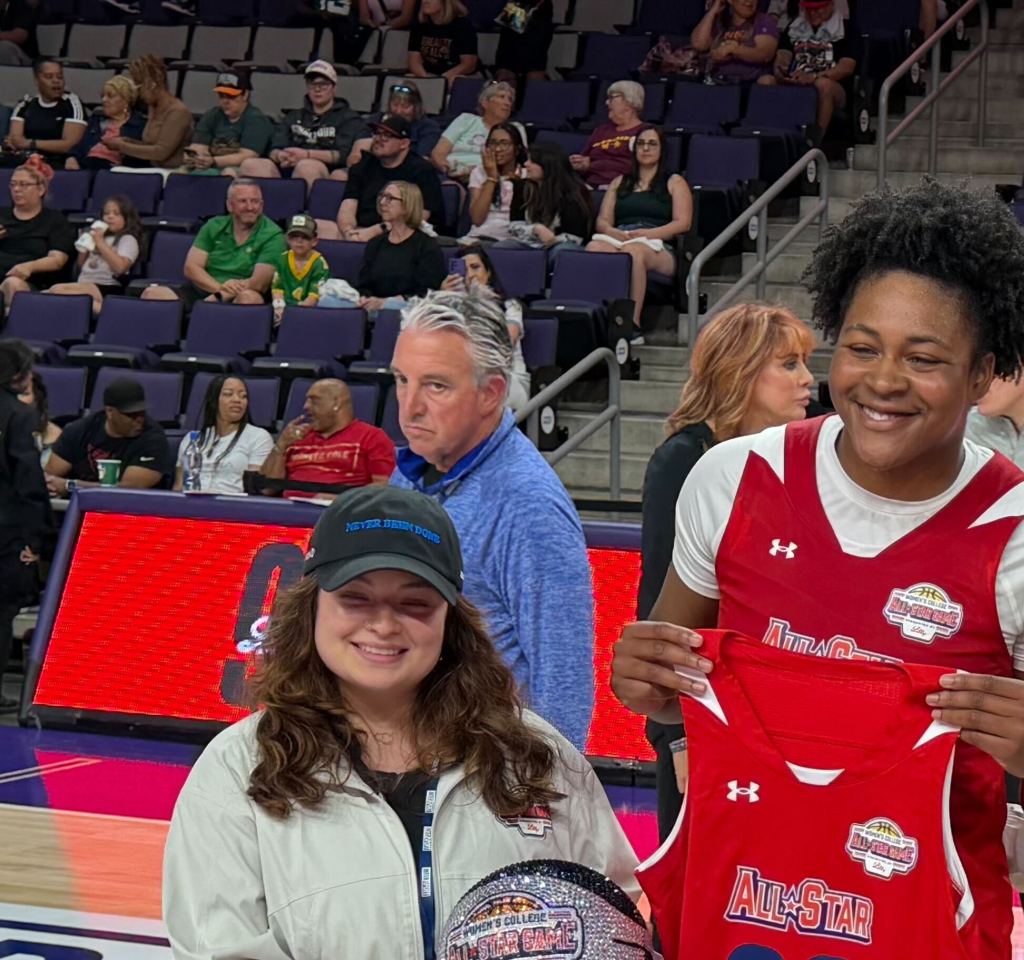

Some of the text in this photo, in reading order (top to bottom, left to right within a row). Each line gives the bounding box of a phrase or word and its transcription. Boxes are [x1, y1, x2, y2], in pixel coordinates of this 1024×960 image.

[345, 518, 441, 544] NEVER BEEN DONE
[462, 912, 548, 938] WOMEN'S COLLEGE
[521, 920, 578, 952] GAME
